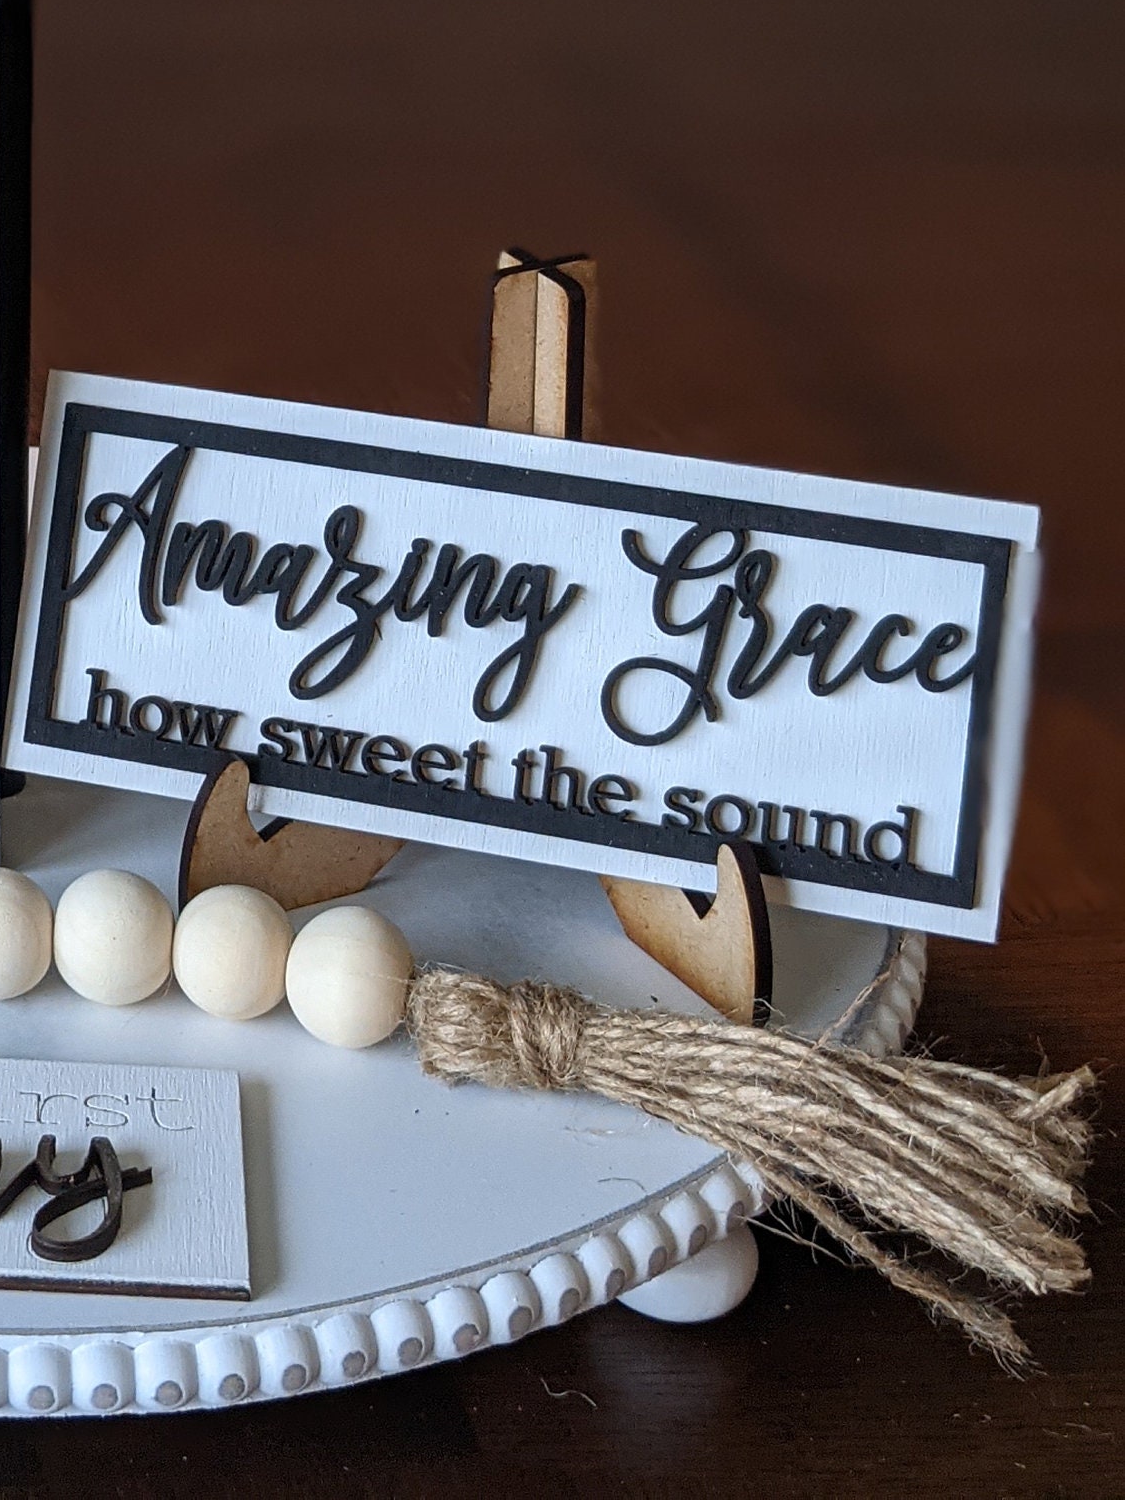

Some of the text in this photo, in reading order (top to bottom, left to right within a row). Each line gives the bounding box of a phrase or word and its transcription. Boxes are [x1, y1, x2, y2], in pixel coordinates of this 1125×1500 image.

[63, 444, 981, 747] Amazing Grace
[79, 667, 925, 872] how sweet the sound
